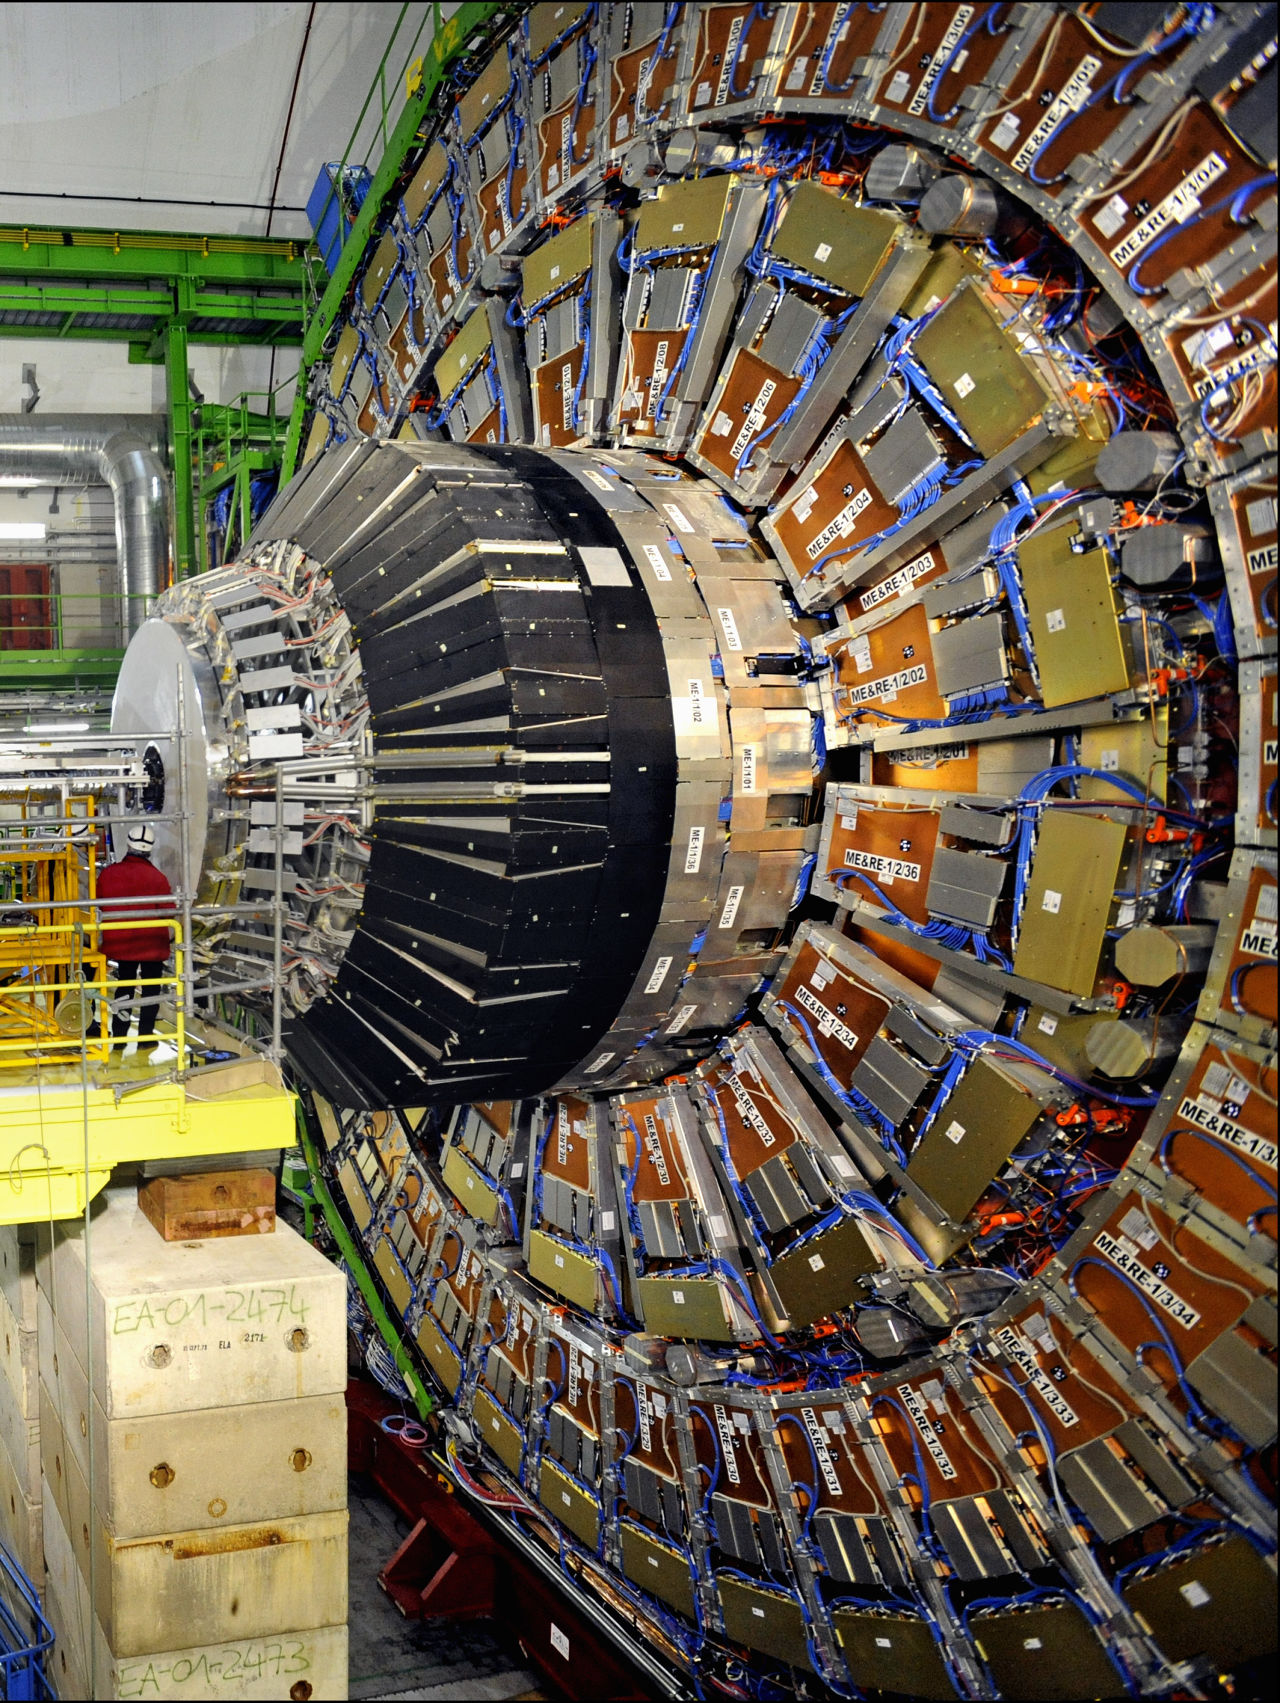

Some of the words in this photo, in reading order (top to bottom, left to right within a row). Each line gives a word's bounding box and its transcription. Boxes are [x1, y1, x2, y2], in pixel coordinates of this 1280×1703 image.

[911, 8, 971, 113] ME&RE-1/3/06
[1015, 58, 1098, 170] ME&RE-1/3/05
[1113, 156, 1221, 265] ME&RE-1/3/04
[732, 382, 775, 457] ME&RE-1/2/06
[808, 493, 870, 557] ME&RE-1/2/04
[862, 555, 933, 609] ME&RE-1/2/03
[851, 666, 926, 704] ME&RE-1/2/02
[743, 748, 753, 791] ME-1/1/01
[686, 828, 701, 871] ME-1/1/36
[846, 851, 919, 880] ME&RE-1/2/36
[721, 888, 741, 926] ME-1/1/35
[796, 987, 857, 1048] ME&RE-1/2/34
[730, 1077, 774, 1146] ME&RE-1/2/32
[646, 1116, 669, 1184] ME&RE-1/2/30
[114, 1285, 312, 1336] EA-01-2474
[1096, 1234, 1196, 1326] ME&RE-1/3/34
[999, 1329, 1075, 1424] ME&RE-1/3/33
[715, 1405, 740, 1482] ME&RE-1/3/30
[803, 1409, 840, 1493] ME&RE-1/3/31
[899, 1385, 954, 1478] ME&RE-1/3/32
[118, 1640, 313, 1698] EA-01-2473
